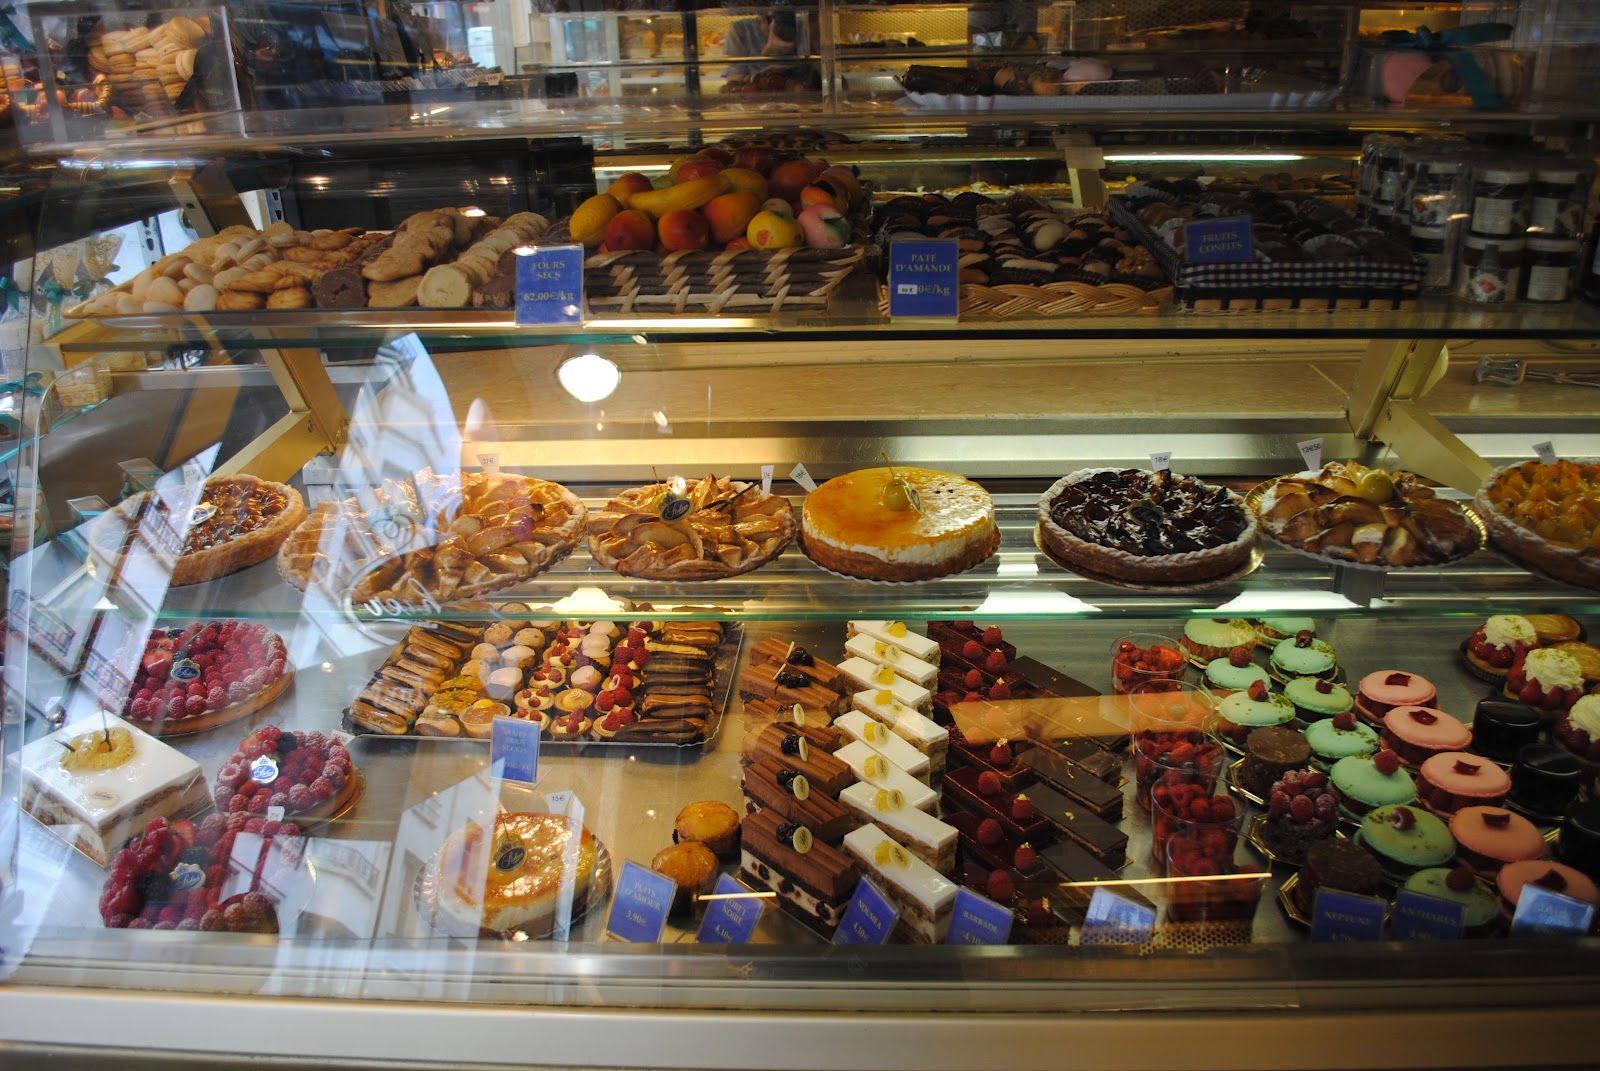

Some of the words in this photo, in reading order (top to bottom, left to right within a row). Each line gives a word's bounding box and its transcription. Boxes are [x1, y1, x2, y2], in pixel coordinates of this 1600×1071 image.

[533, 261, 566, 270] FOURS
[895, 264, 953, 272] D'AMANDE
[537, 271, 561, 280] SECS
[634, 881, 656, 897] PUITS
[624, 888, 661, 911] D'AMOUR
[722, 905, 743, 926] NOIRE
